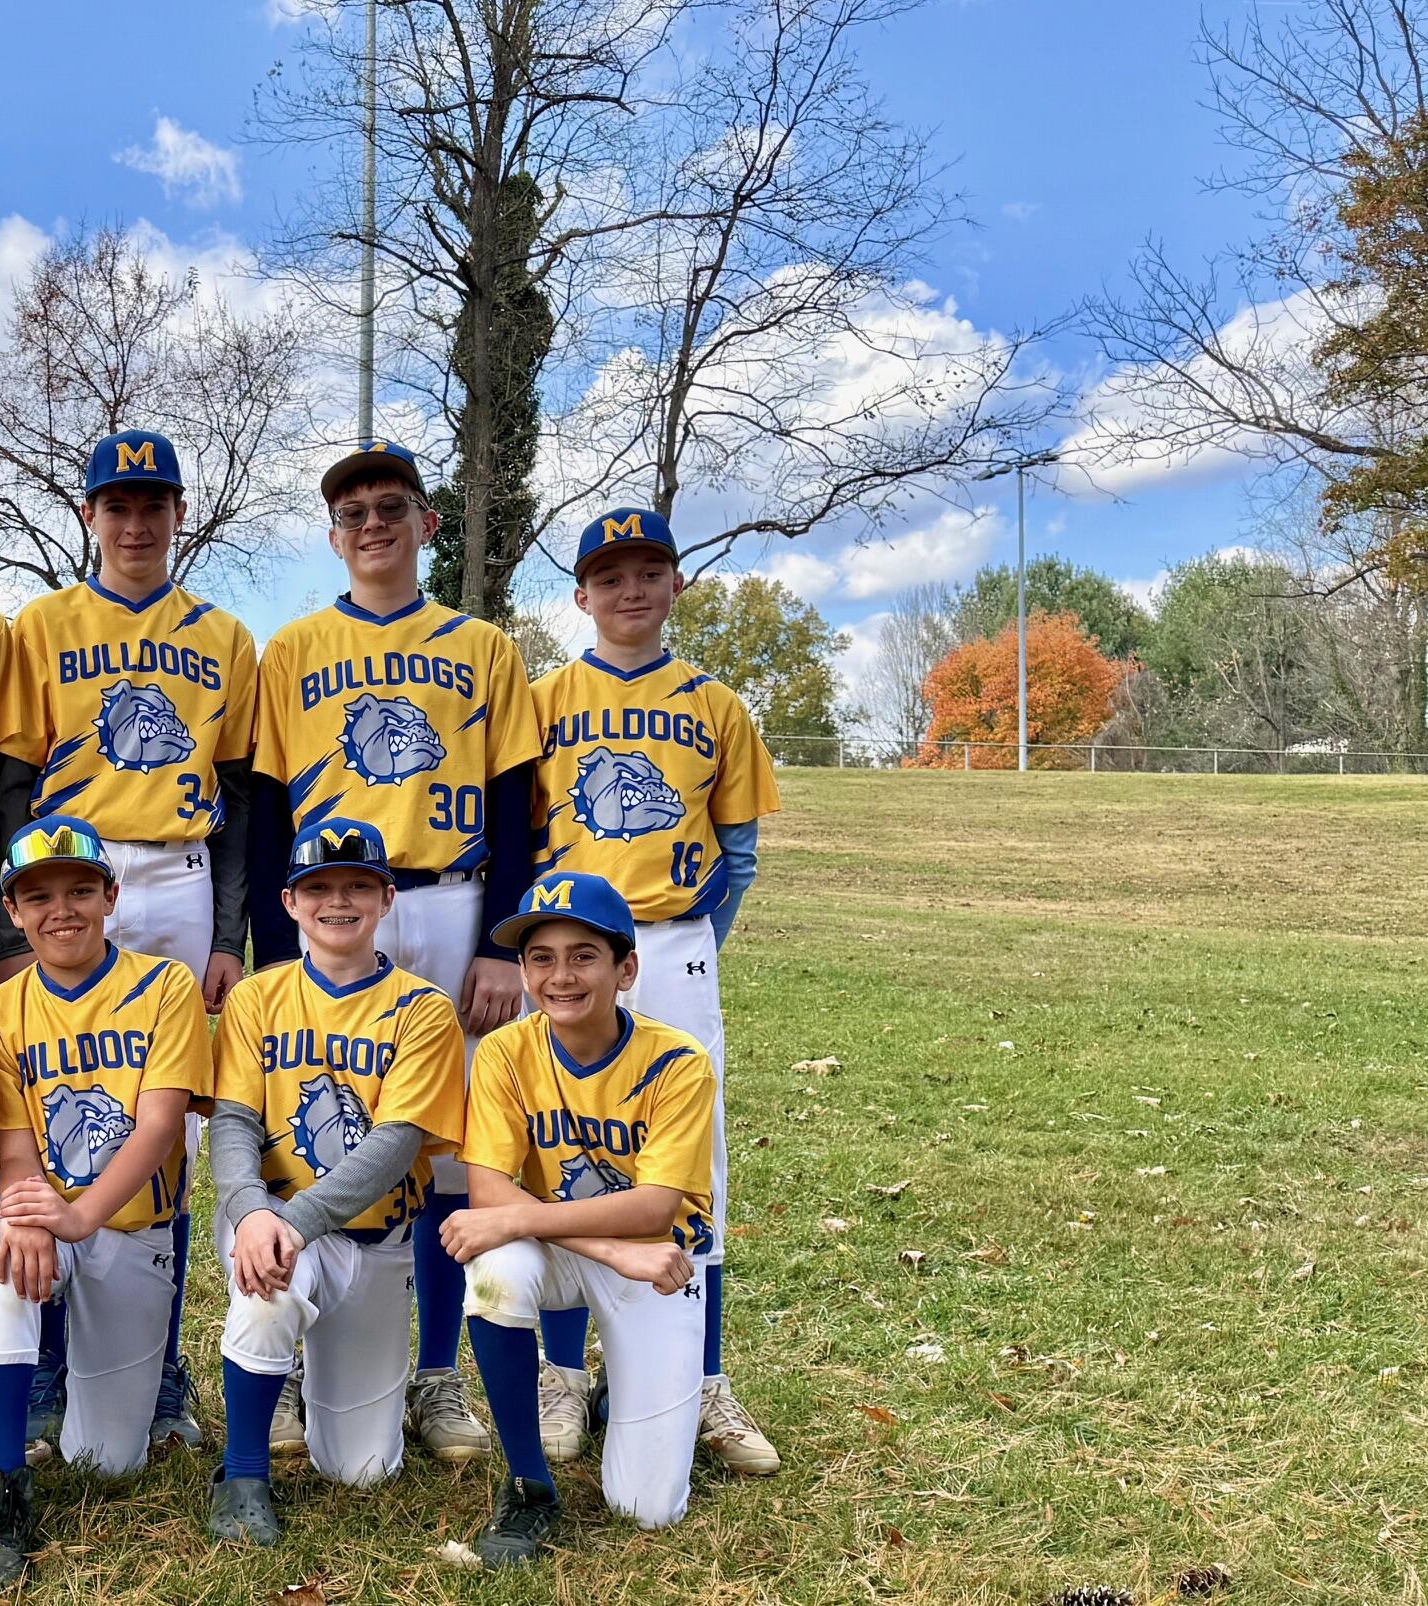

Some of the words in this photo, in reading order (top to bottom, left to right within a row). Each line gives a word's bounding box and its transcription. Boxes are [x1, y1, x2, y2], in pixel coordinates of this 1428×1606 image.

[116, 441, 157, 473] M
[602, 513, 645, 543] M
[59, 638, 221, 691] BULLDOGS
[301, 652, 473, 711] BULLDOGS
[541, 708, 714, 760] BULLDOGS
[428, 782, 484, 834] 30
[531, 880, 574, 912] M
